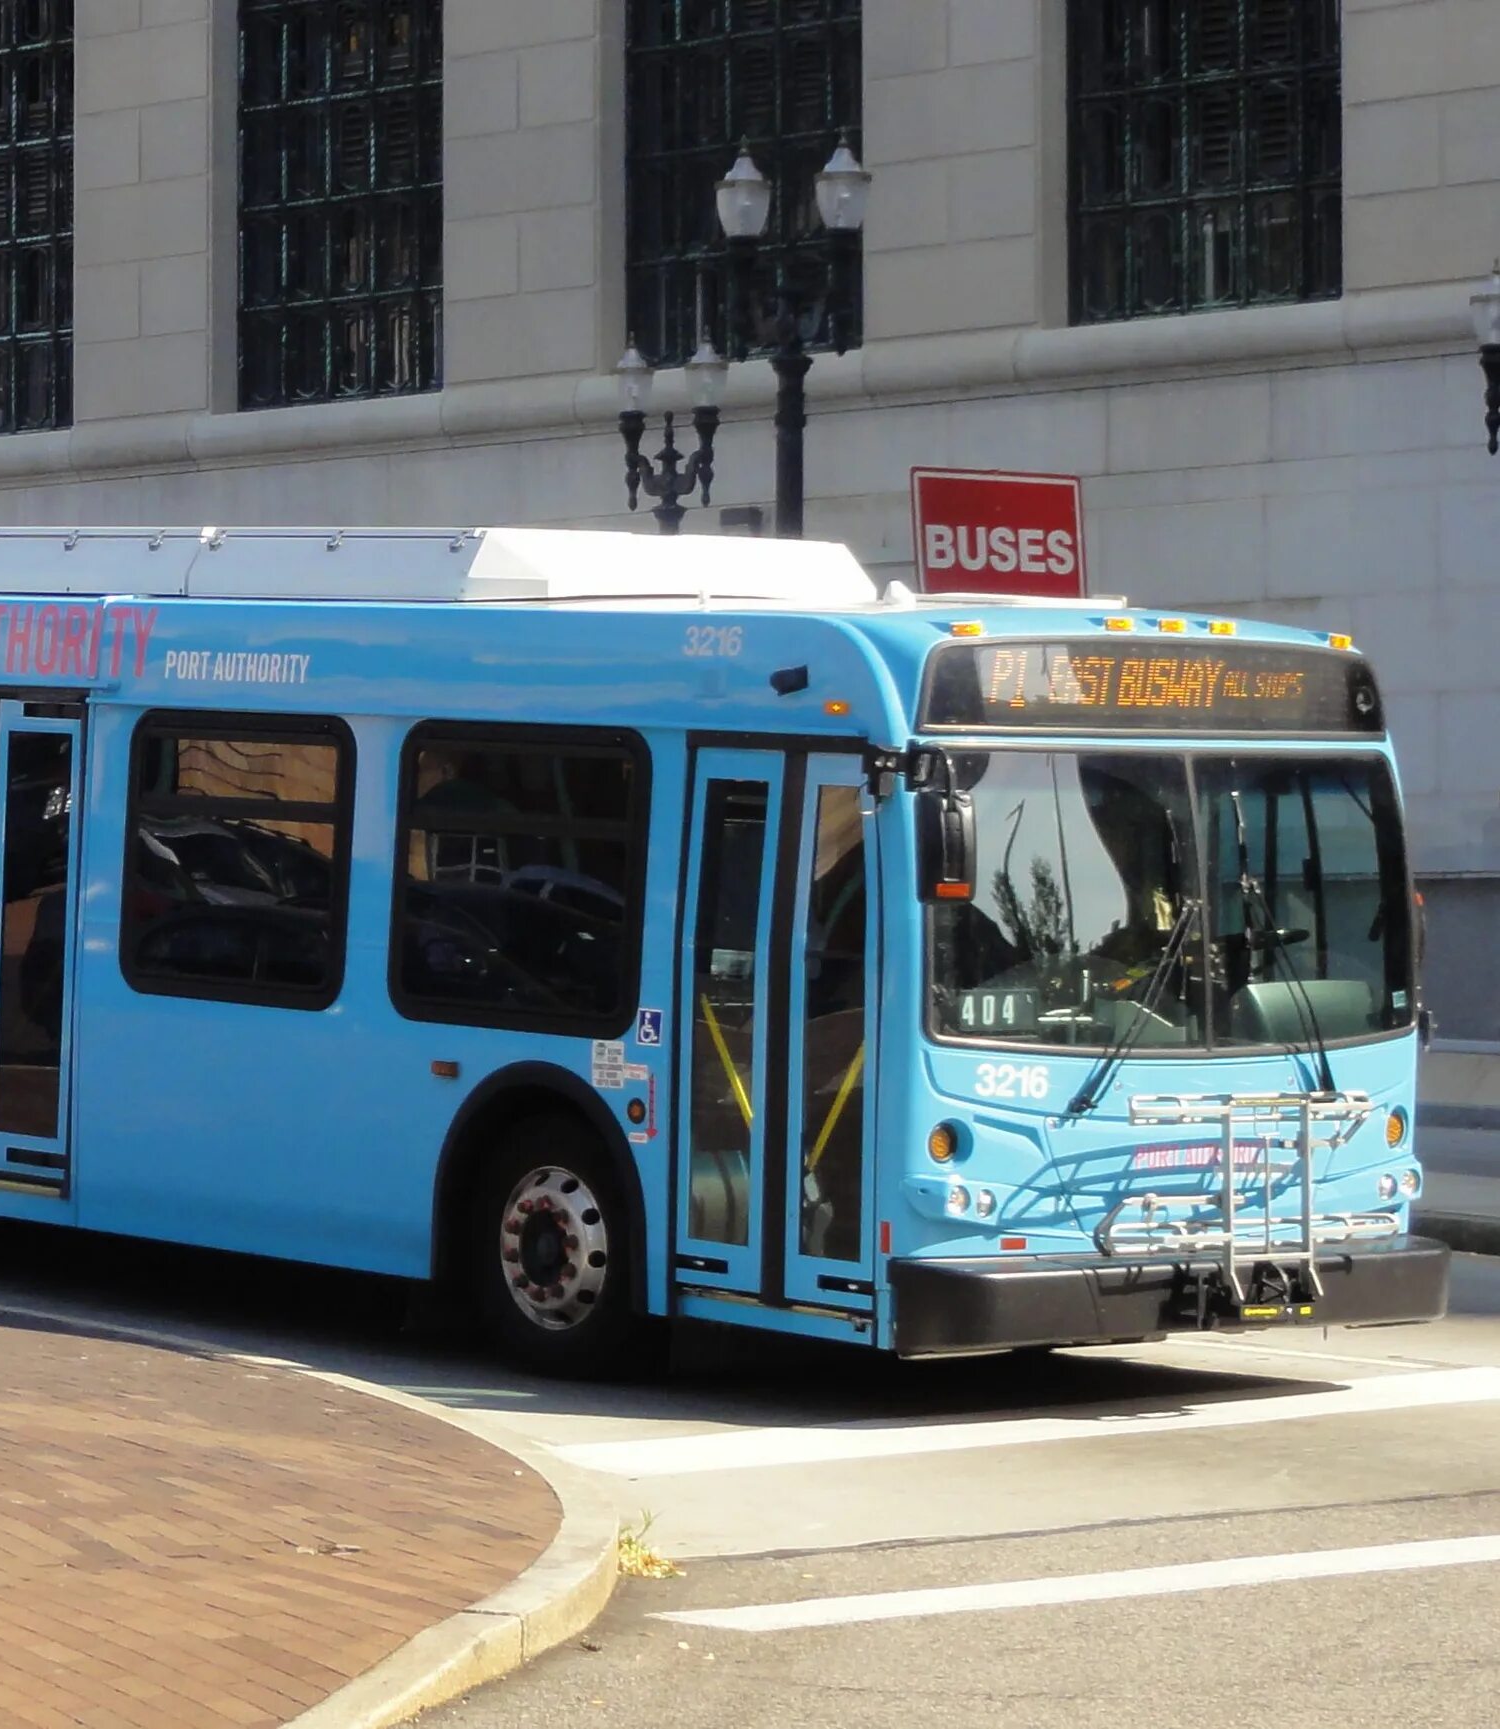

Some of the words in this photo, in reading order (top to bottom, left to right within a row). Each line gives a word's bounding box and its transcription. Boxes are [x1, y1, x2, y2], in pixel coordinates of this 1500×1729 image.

[925, 524, 1075, 575] BUSES
[682, 625, 743, 657] 3216
[164, 650, 211, 681] PORT
[212, 652, 311, 685] AUTHORITY
[989, 649, 1028, 708] P1
[1049, 656, 1116, 705] EAST
[1117, 655, 1227, 707] BUSWAY
[1223, 670, 1248, 698] ALL
[1253, 672, 1305, 698] STOPS
[961, 994, 1016, 1026] 404
[974, 1062, 1049, 1098] 3216
[1134, 1144, 1180, 1169] PORT
